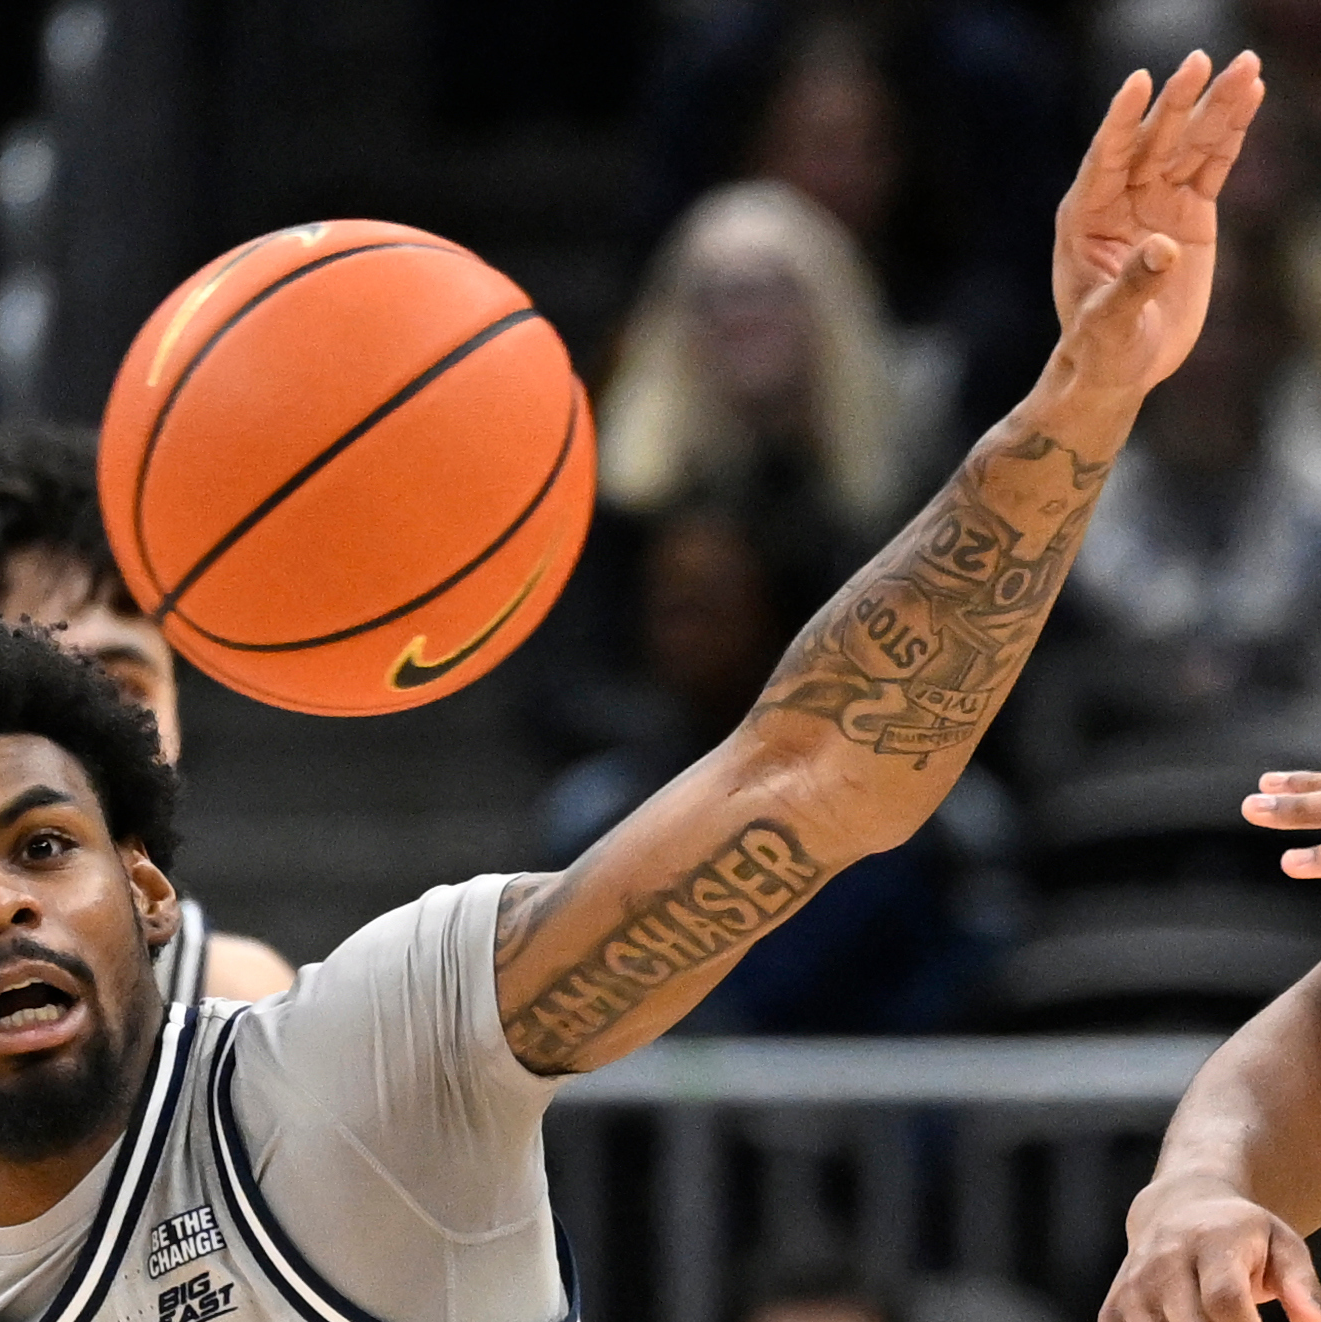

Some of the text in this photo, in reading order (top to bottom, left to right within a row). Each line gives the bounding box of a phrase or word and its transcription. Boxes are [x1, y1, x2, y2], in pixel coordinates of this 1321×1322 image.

[856, 596, 929, 670] STOP
[603, 820, 819, 988] CHASER
[148, 1229, 226, 1279] CHANGE
[151, 1206, 215, 1252] BE THE
[158, 1270, 210, 1315] BIG
